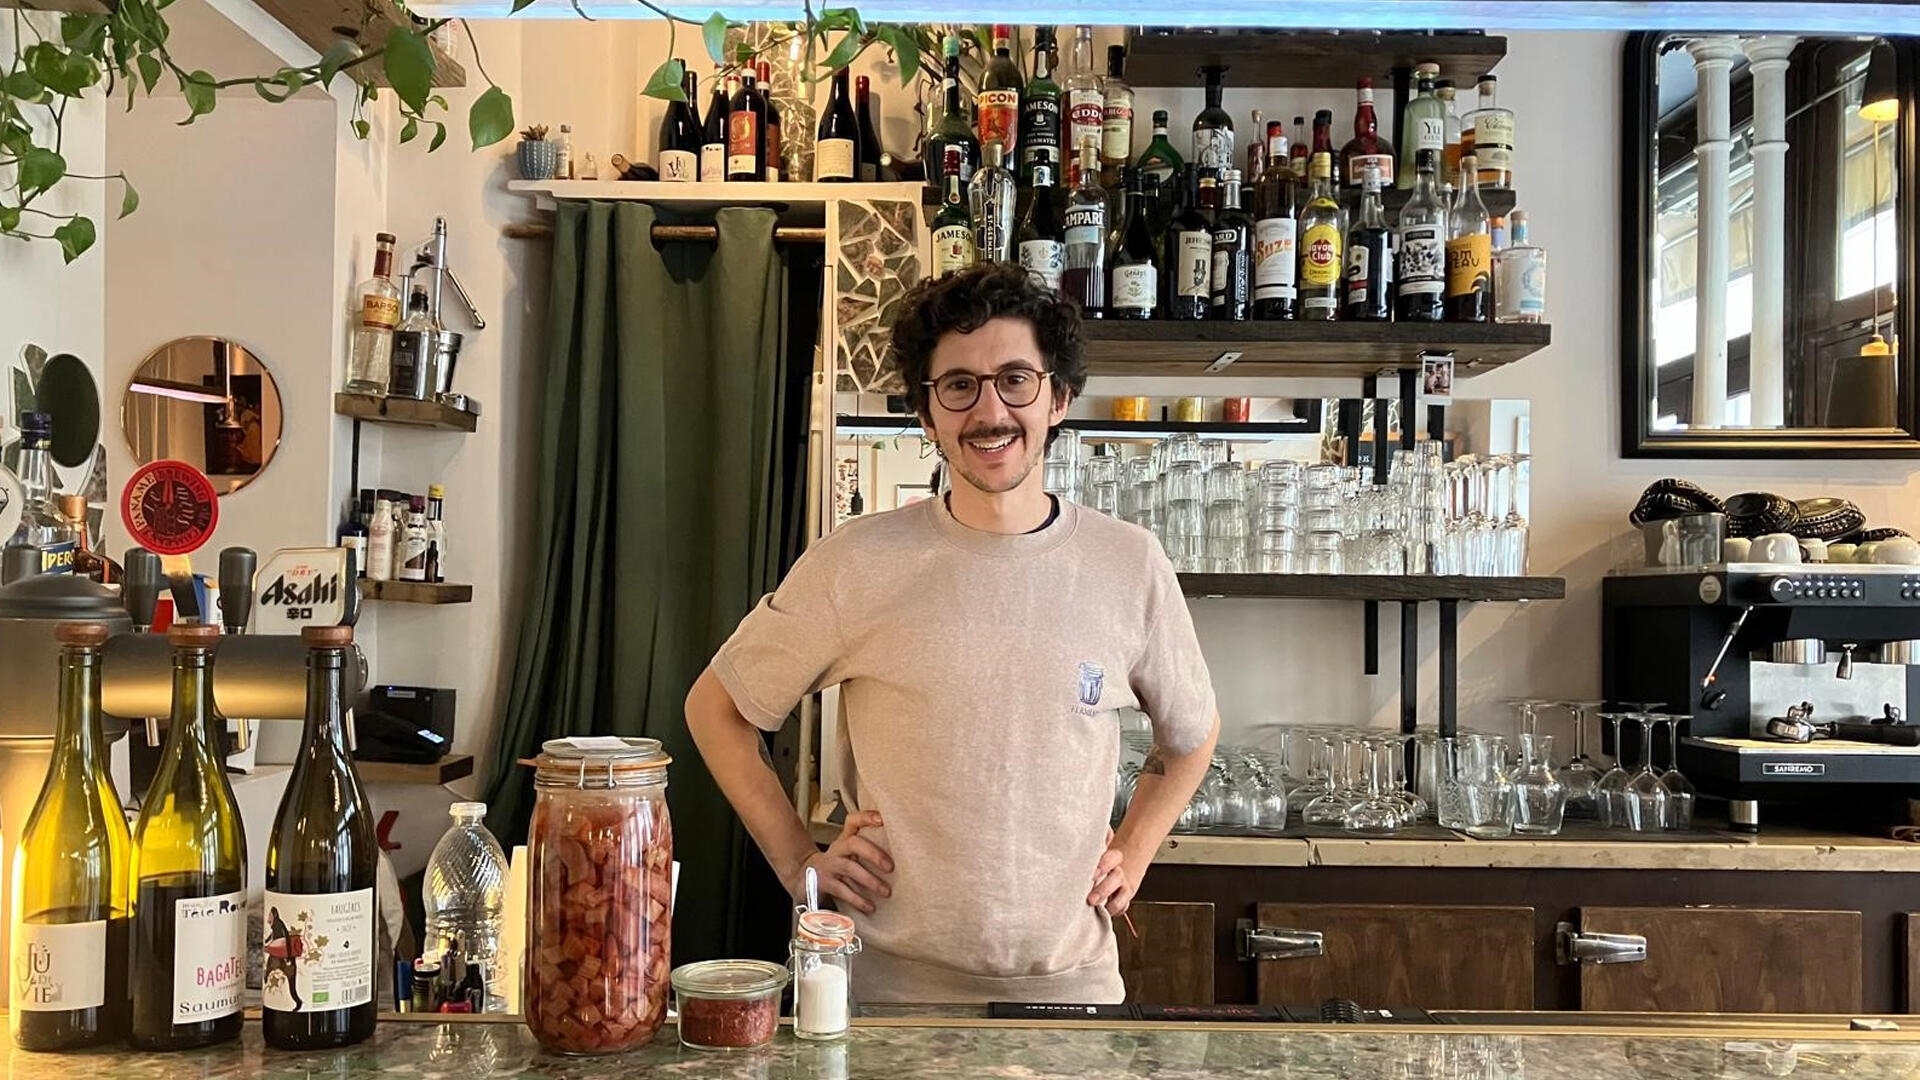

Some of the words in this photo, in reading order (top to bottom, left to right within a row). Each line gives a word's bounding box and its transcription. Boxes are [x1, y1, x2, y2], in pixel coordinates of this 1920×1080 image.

[979, 93, 1016, 104] PICON
[1065, 211, 1104, 226] AMPARI
[1311, 251, 1333, 261] Club
[366, 300, 398, 313] BARSO
[130, 471, 156, 531] PANAME
[260, 572, 338, 606] Asahi
[286, 607, 313, 620] 辛口
